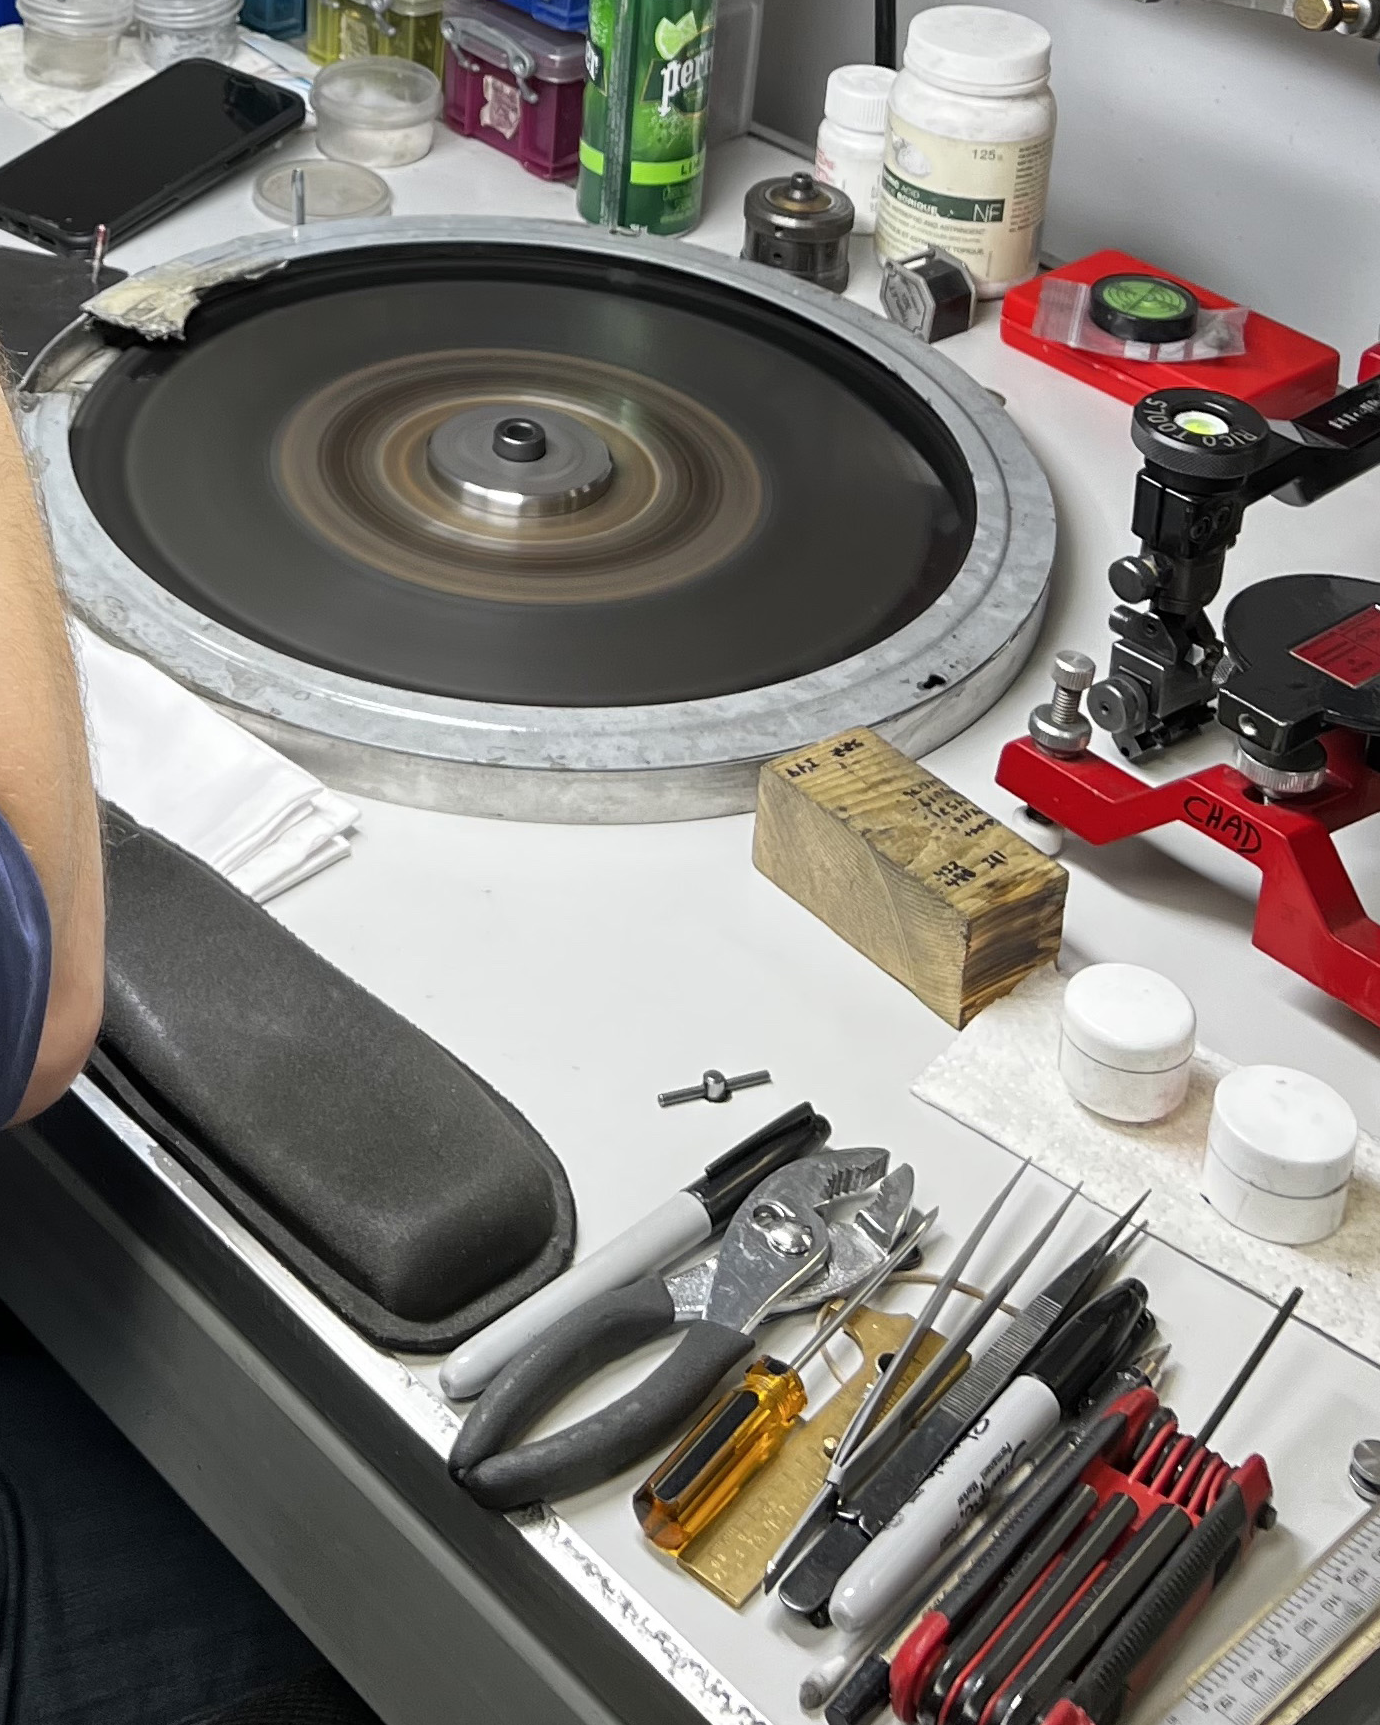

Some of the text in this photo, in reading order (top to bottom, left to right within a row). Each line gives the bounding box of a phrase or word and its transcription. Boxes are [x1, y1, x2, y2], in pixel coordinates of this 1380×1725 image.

[972, 148, 996, 162] 125
[973, 203, 1003, 223] NF
[1143, 397, 1258, 447] RICO TOOLS
[1183, 796, 1262, 854] CHAD
